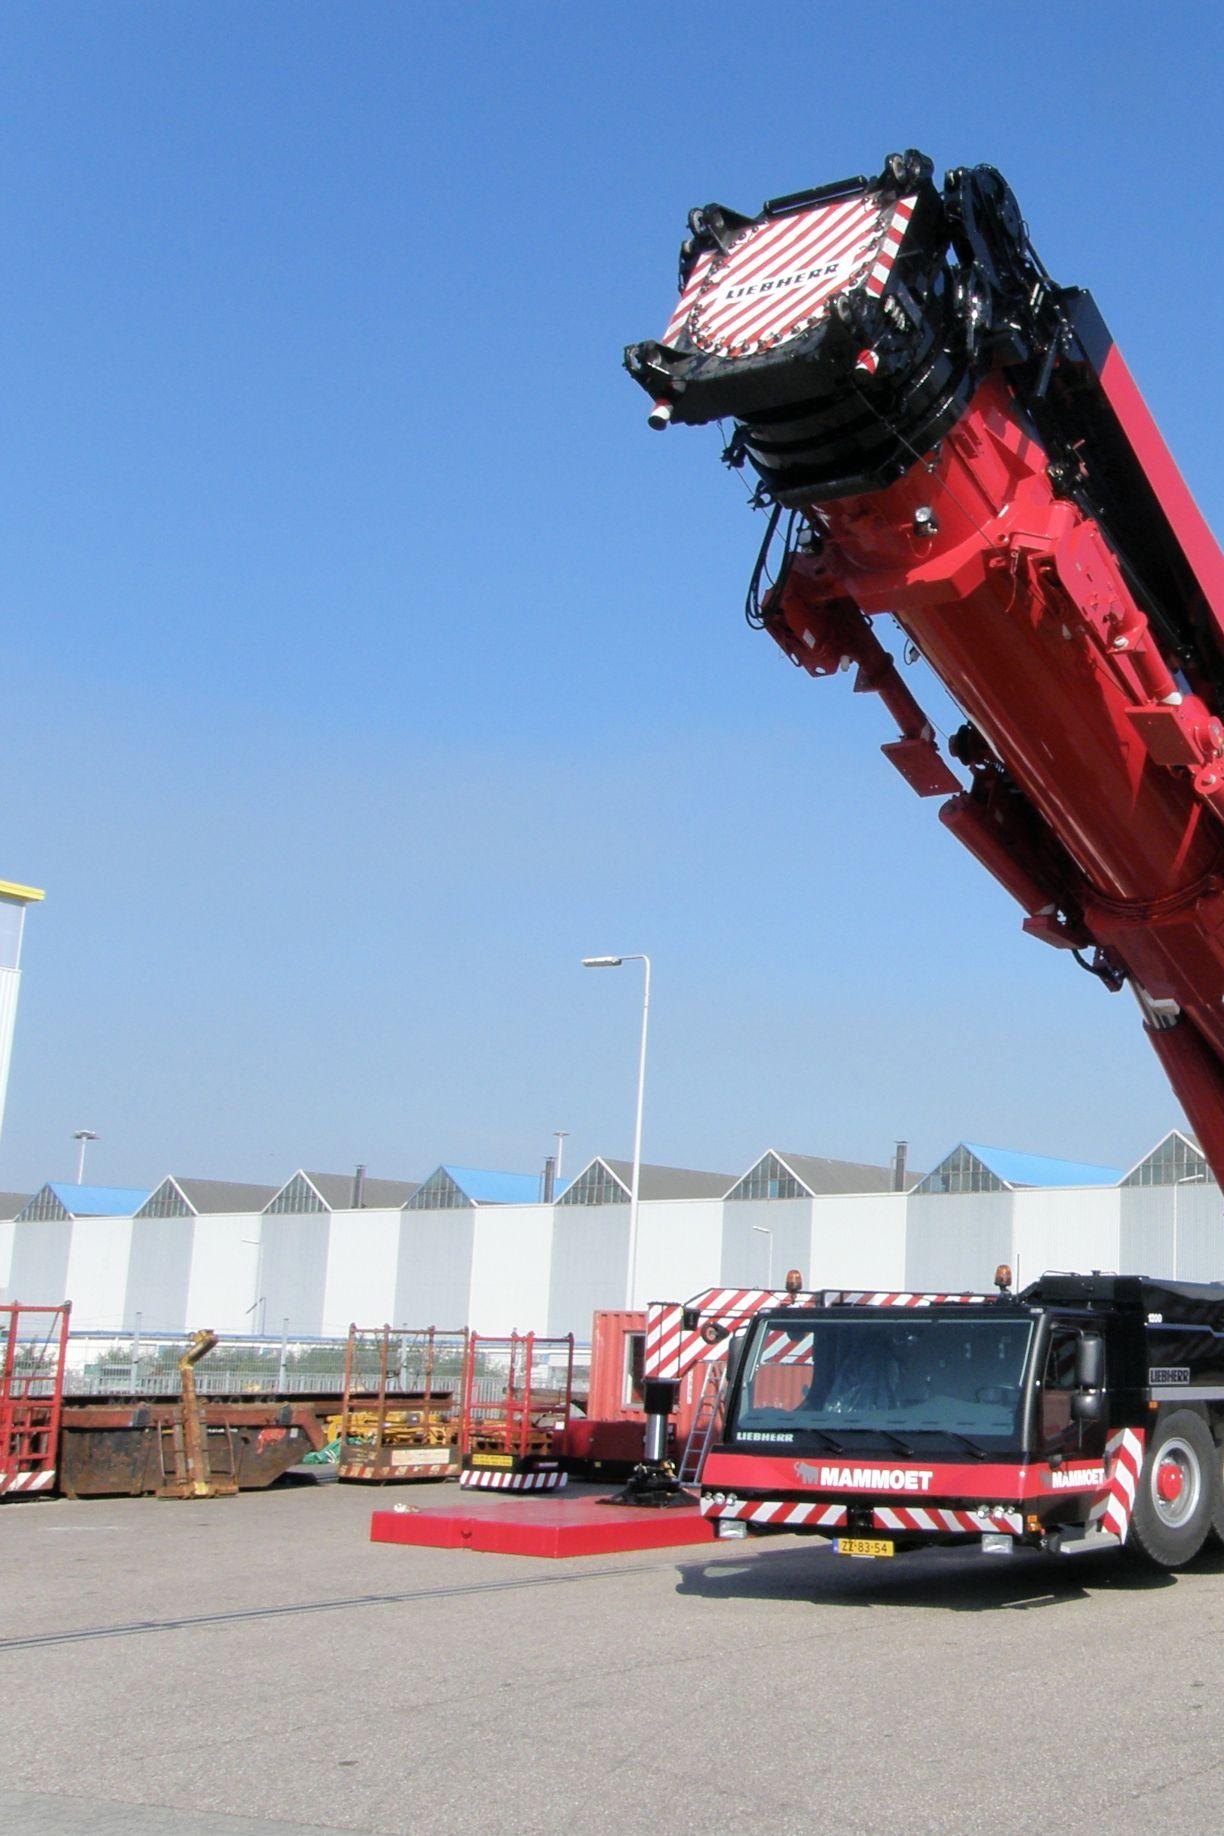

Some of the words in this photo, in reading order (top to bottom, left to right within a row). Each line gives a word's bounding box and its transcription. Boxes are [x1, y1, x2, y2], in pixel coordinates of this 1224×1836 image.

[725, 263, 840, 299] LIEBHERR
[1150, 1369, 1189, 1383] LIEBHERR
[736, 1431, 794, 1442] LIEBHERR
[820, 1466, 933, 1491] MAMMOET
[1052, 1467, 1105, 1488] MAMMOET
